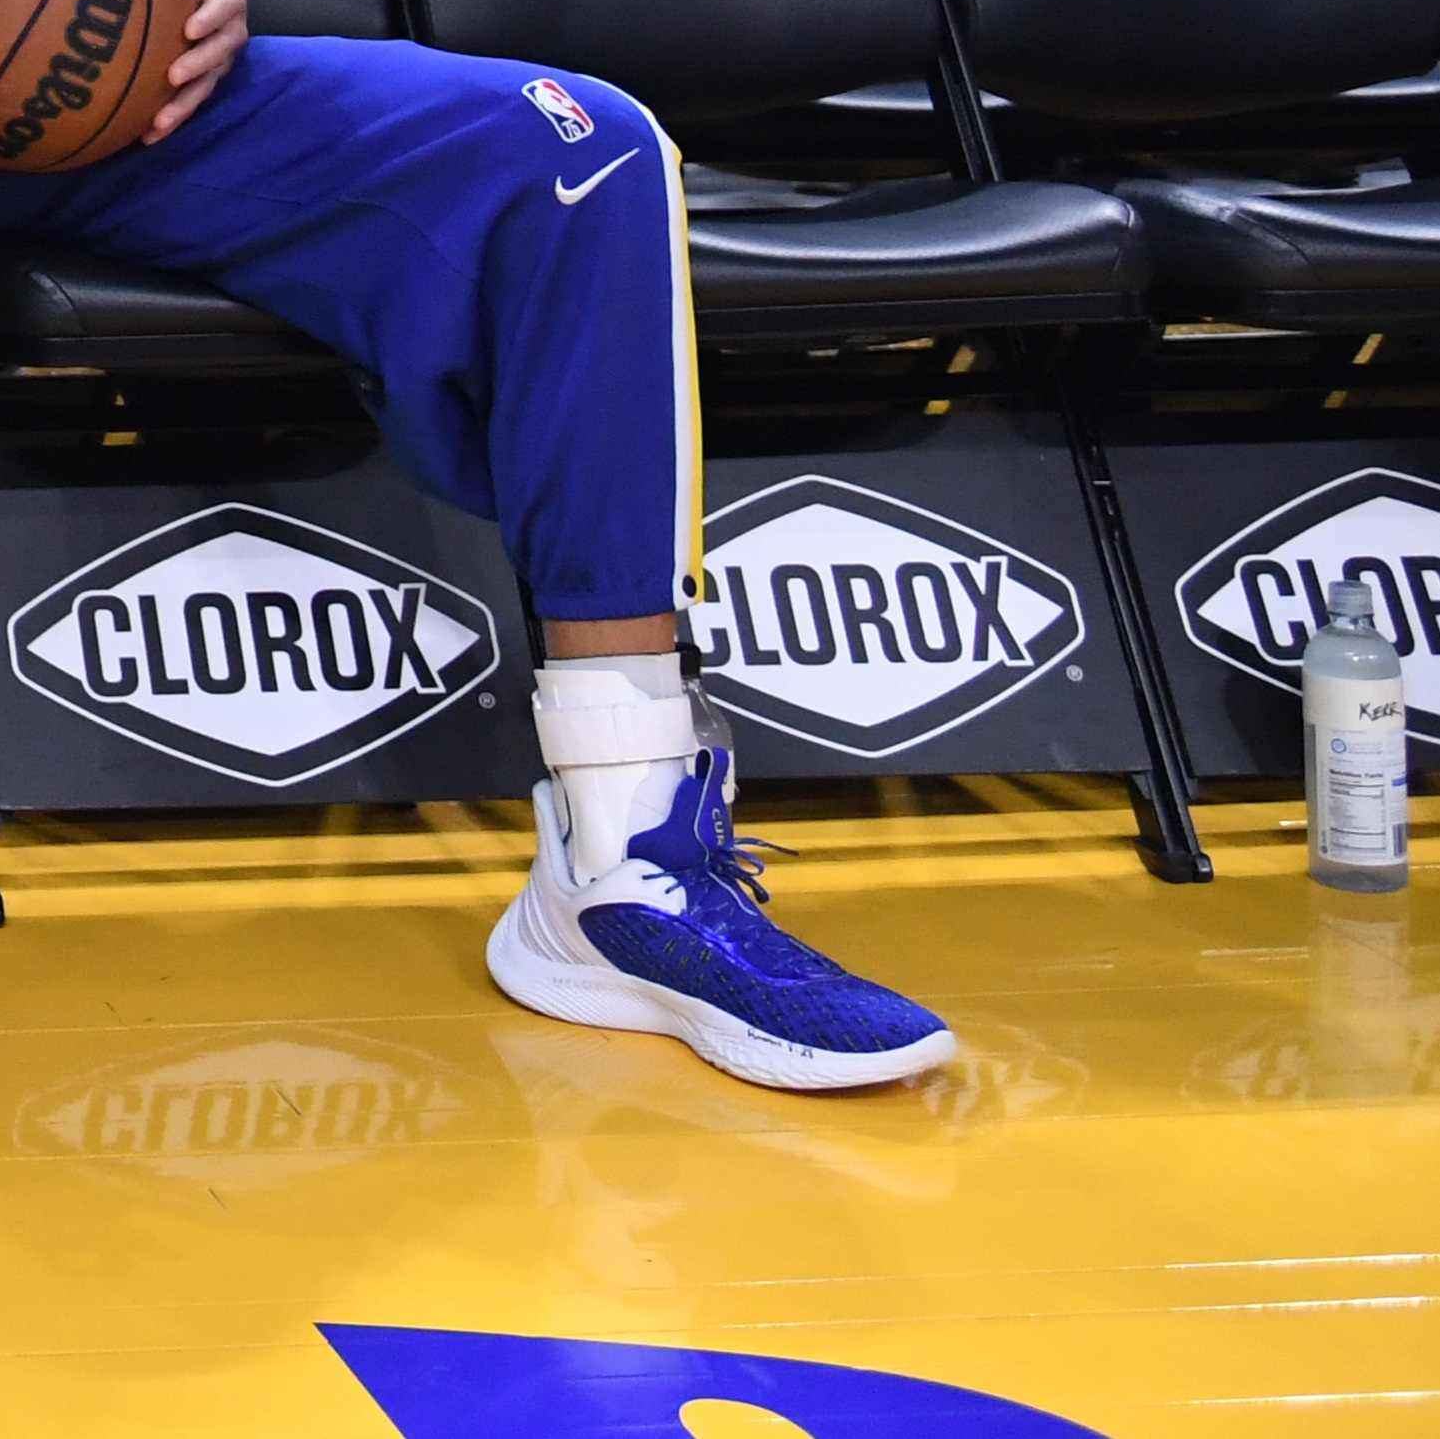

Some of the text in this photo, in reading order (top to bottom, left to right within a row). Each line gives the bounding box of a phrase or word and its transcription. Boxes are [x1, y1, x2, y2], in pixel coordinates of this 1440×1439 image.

[77, 586, 438, 697] CLOROX
[1239, 556, 1440, 662] CLOR
[1359, 701, 1403, 721] KERR
